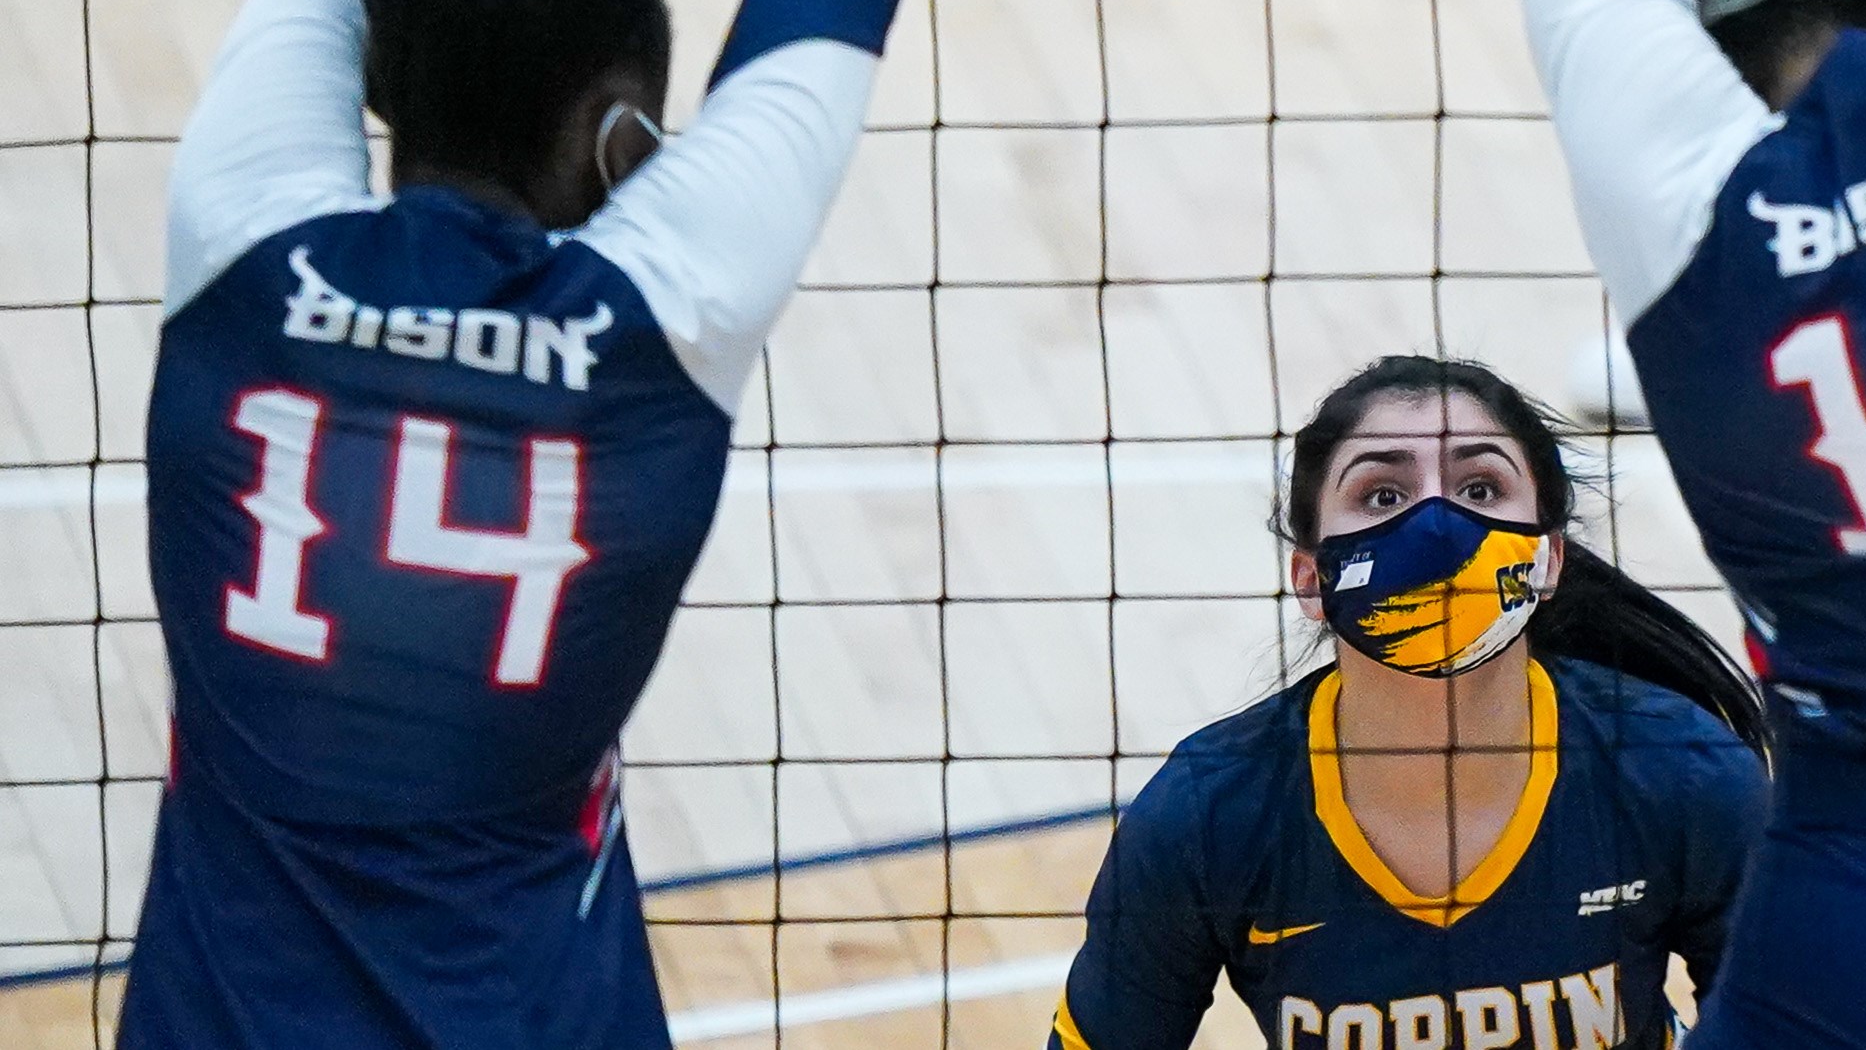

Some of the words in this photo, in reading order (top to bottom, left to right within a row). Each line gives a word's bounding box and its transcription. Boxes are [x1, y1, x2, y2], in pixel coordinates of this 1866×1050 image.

[283, 244, 614, 392] BISON
[220, 380, 602, 691] 14
[1277, 962, 1626, 1050] COPPIN
